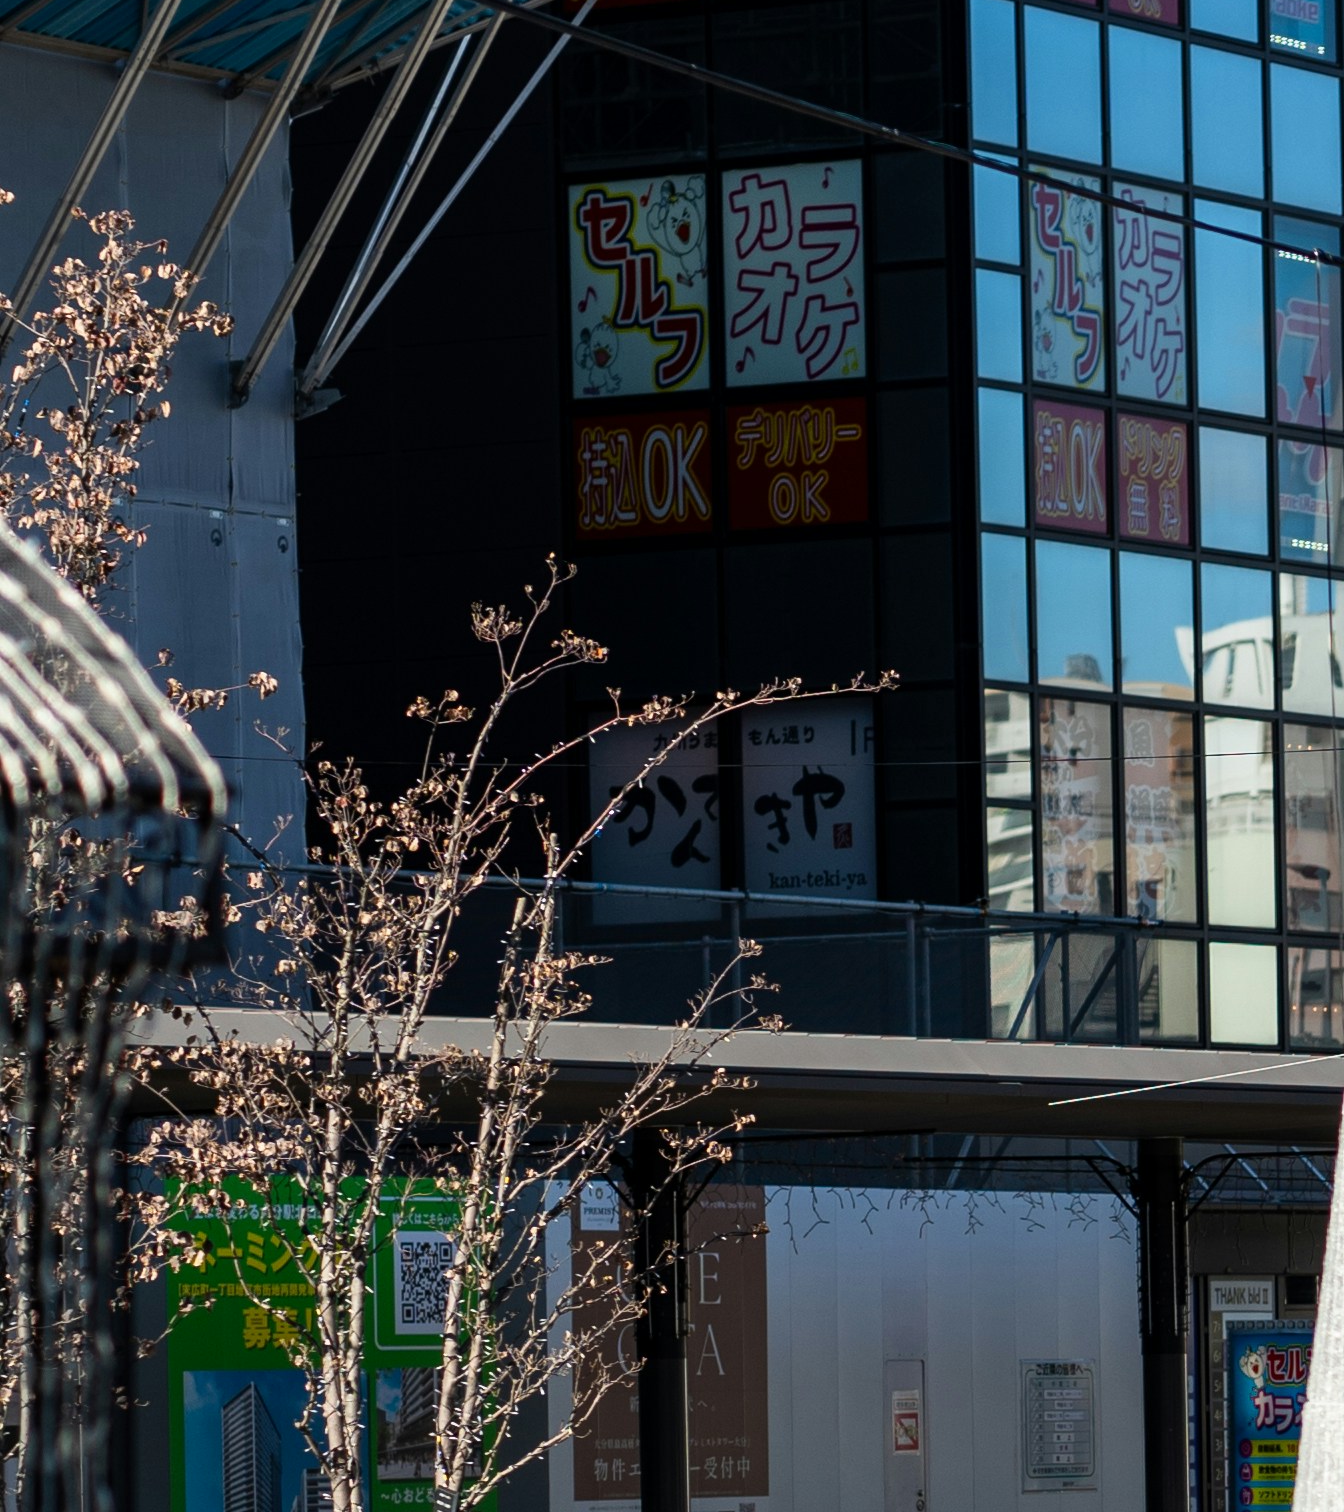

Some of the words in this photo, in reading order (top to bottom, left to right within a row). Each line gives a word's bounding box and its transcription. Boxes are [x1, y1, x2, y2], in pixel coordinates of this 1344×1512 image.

[578, 192, 703, 385] セルフ
[729, 174, 859, 379] カラオケ
[1032, 175, 1100, 384] セルフ
[1115, 189, 1184, 399] カラオケ
[580, 423, 709, 526] 持込OK
[736, 408, 860, 467] デリバリー
[770, 473, 828, 522] OK
[768, 869, 867, 891] kan-teki-ya
[1214, 1287, 1247, 1305] THANK
